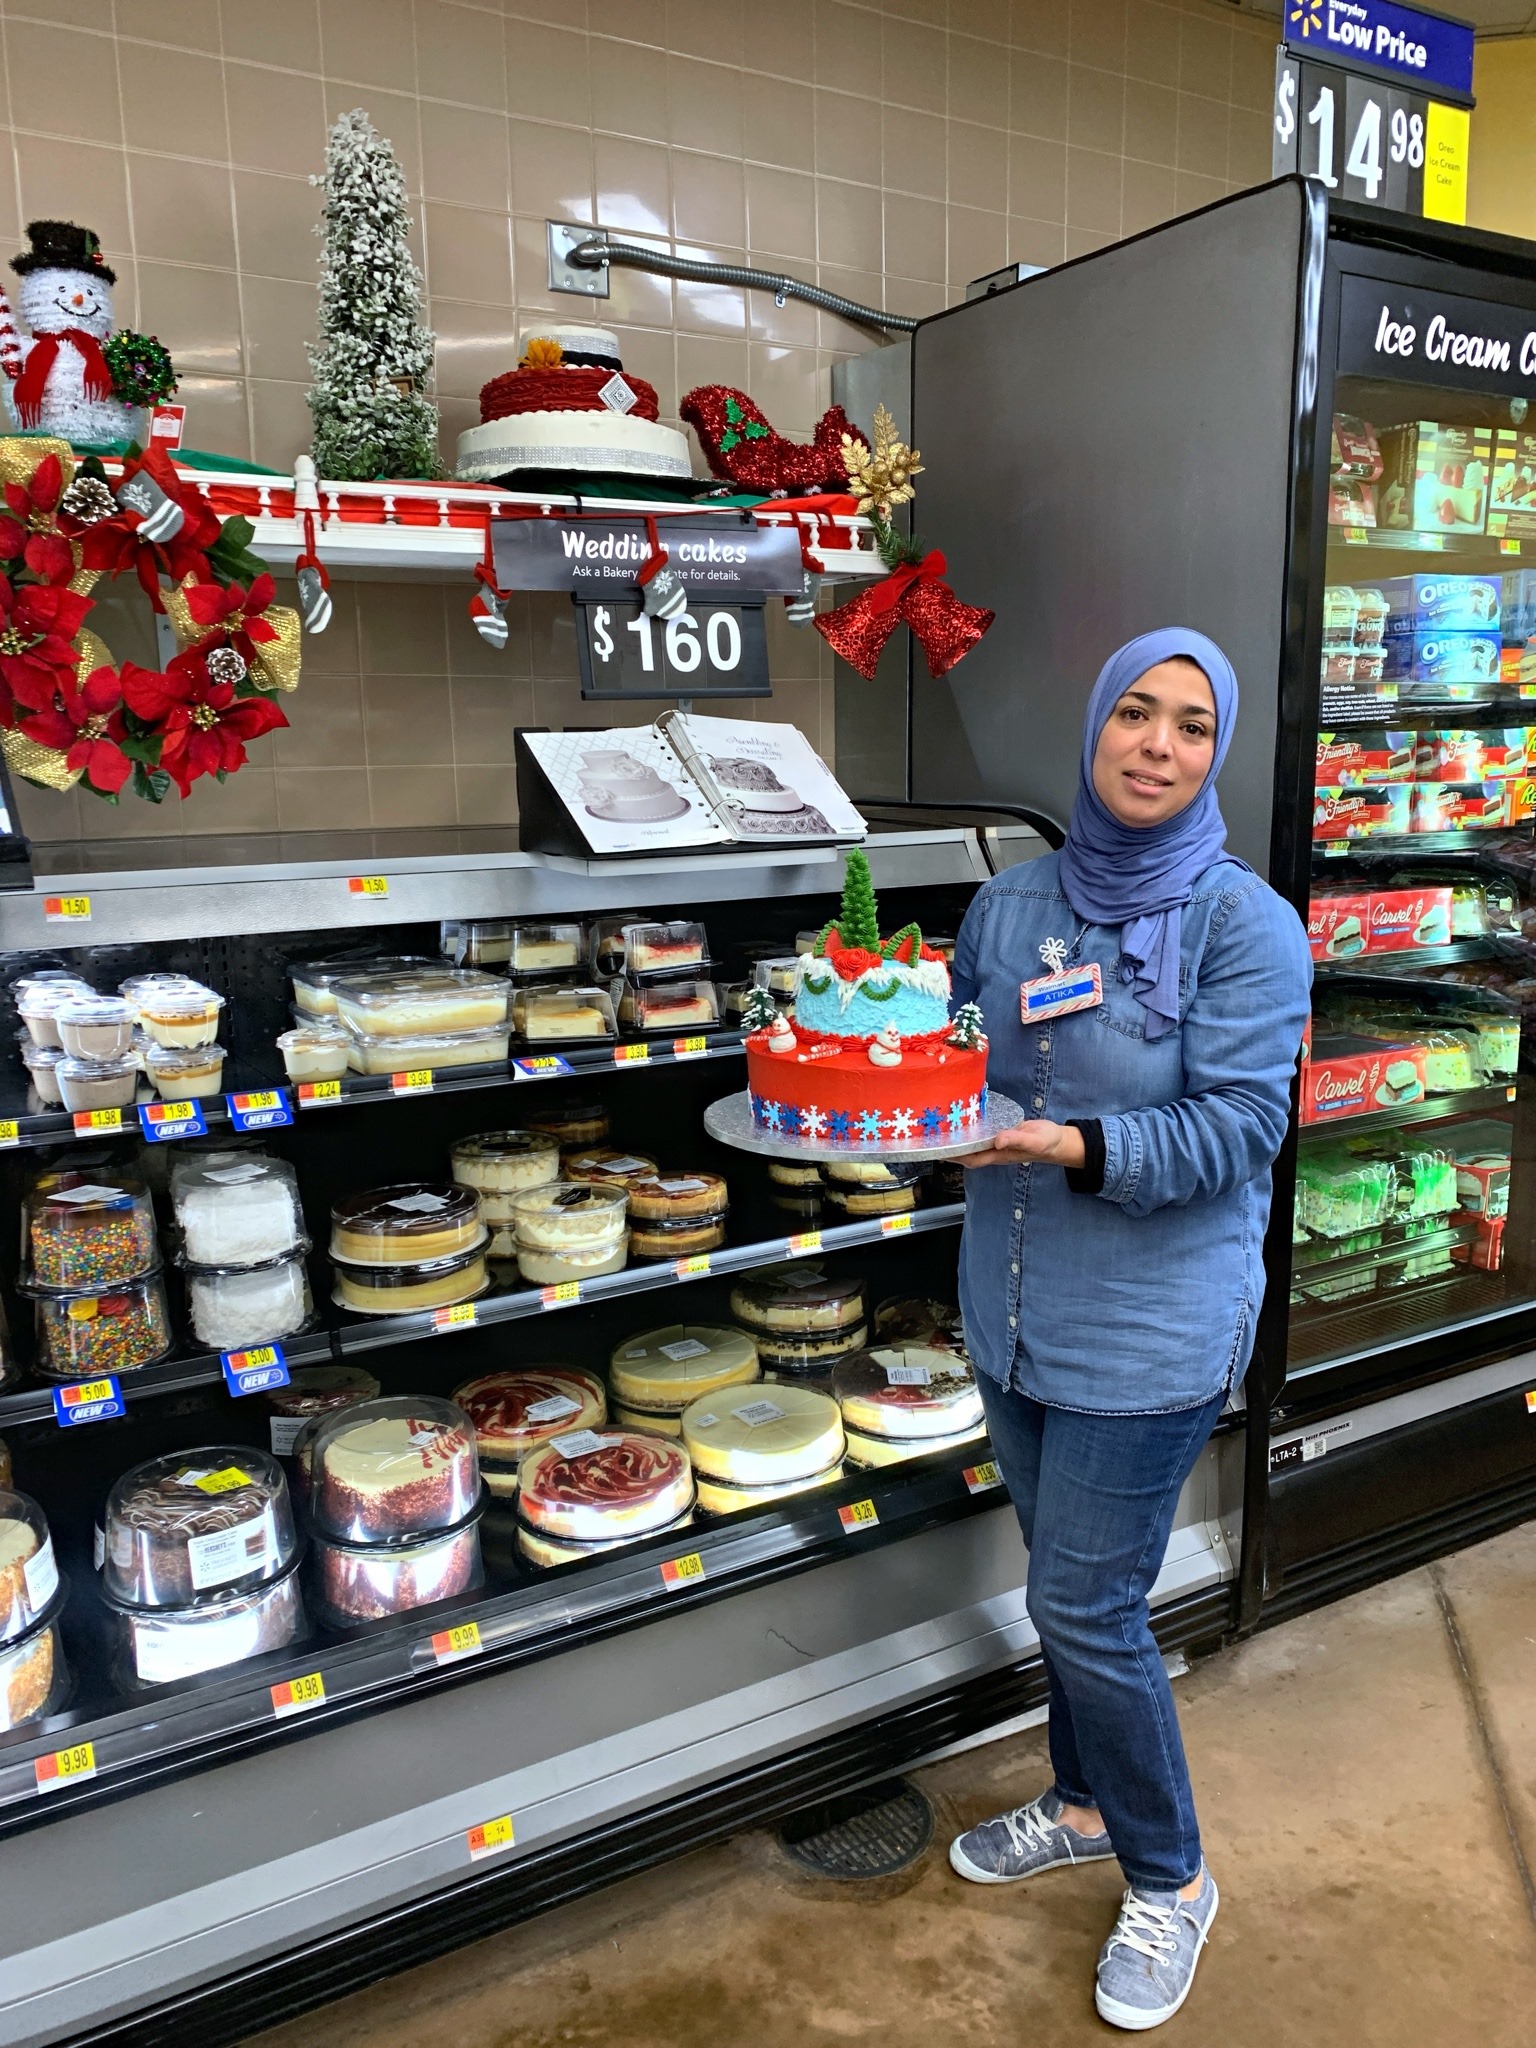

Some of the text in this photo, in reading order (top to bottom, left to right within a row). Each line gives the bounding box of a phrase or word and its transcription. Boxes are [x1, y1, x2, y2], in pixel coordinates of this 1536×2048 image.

[1329, 0, 1367, 22] Everyday
[1328, 10, 1427, 68] Low Price
[1276, 70, 1295, 144] $
[1438, 142, 1455, 154] Oreo
[1429, 157, 1461, 172] Ice Cream
[1436, 174, 1452, 185] Cake
[1375, 306, 1416, 356] Ice
[1425, 315, 1510, 372] Cream
[679, 538, 747, 564] cakes
[572, 565, 592, 577] Ask
[594, 569, 601, 577] a
[603, 567, 638, 581] Bakery
[690, 570, 705, 580] for
[707, 571, 741, 581] details.
[1419, 581, 1468, 604] OREO
[594, 605, 742, 673] $ 160
[1421, 637, 1470, 661] OREO
[1323, 685, 1340, 693] Allergy
[1316, 743, 1359, 766] Friendly's
[1325, 798, 1364, 820] Friendly's
[1372, 902, 1413, 926] Carvel
[1038, 981, 1066, 992] Walmart
[1045, 988, 1074, 1002] ATIKA
[1315, 1069, 1367, 1101] Carvel
[248, 1113, 274, 1125] NEW
[160, 1123, 187, 1136] NEW
[243, 1372, 269, 1389] NEW
[73, 1404, 102, 1420] NEW
[1318, 1422, 1350, 1437] PHOENIX
[1275, 1446, 1297, 1463] LTA-2
